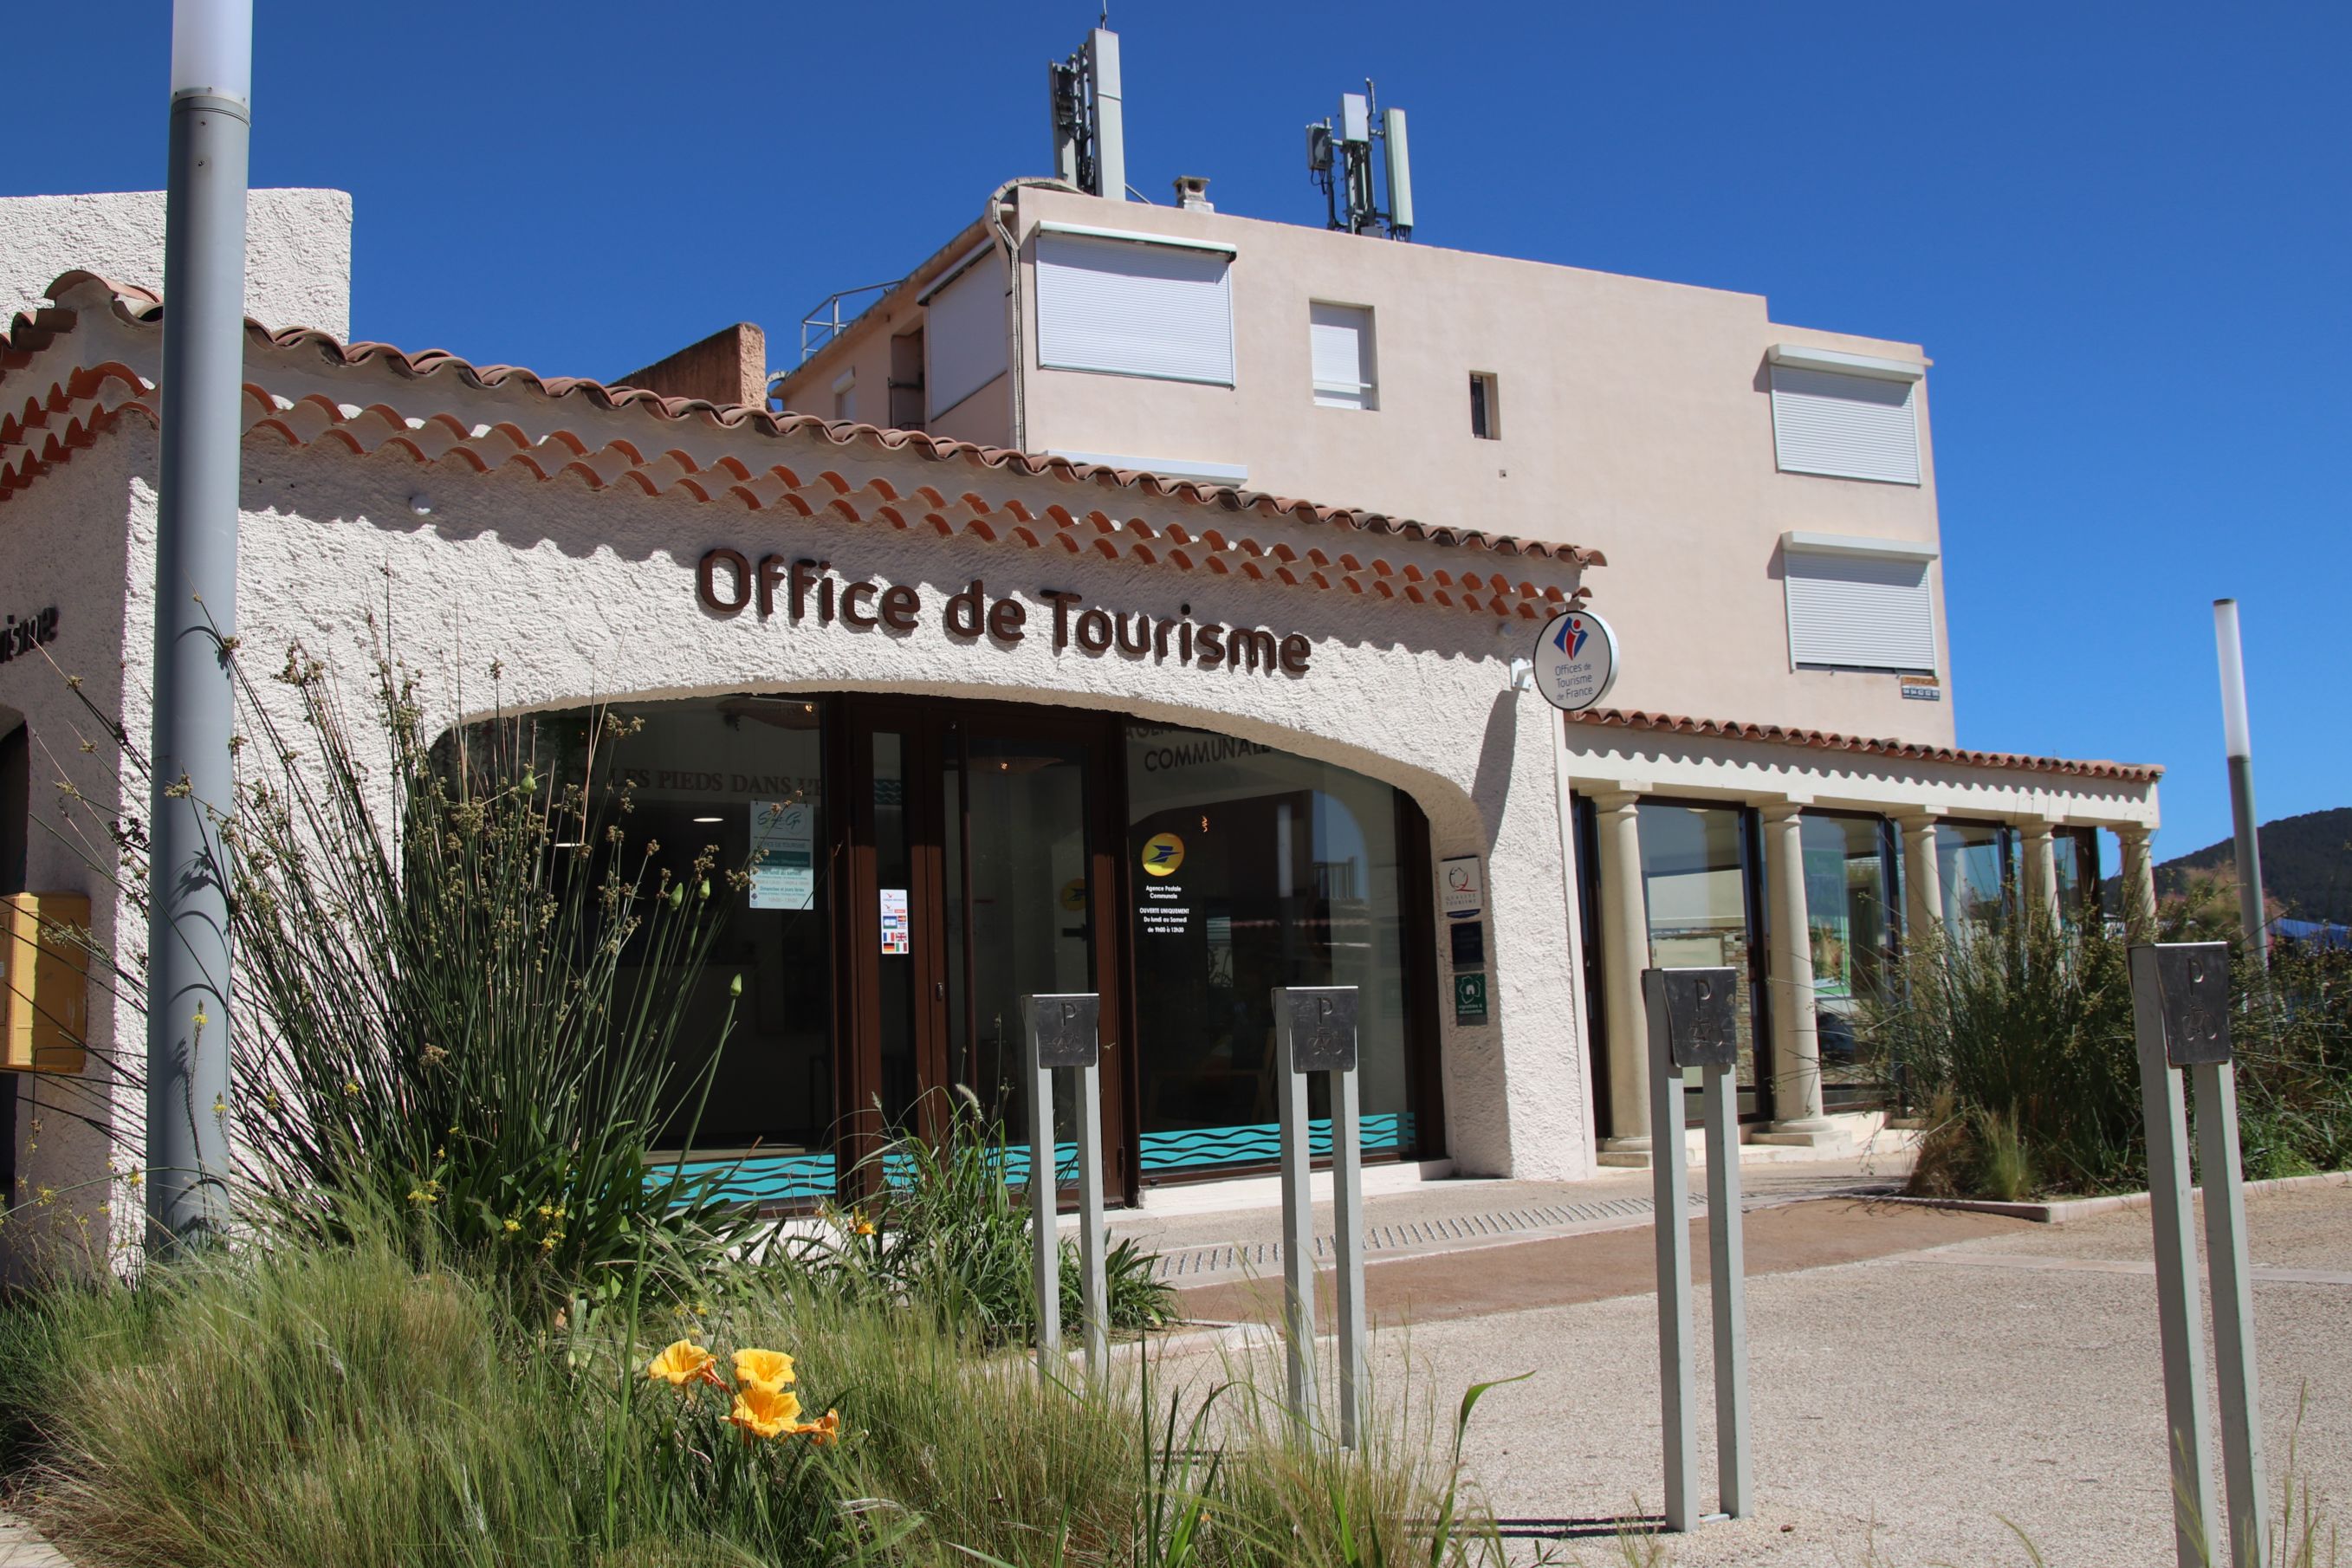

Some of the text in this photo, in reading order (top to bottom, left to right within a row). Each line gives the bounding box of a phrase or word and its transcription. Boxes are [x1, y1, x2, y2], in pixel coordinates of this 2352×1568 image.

[699, 548, 1312, 673] Office de Tourisme
[1554, 664, 1582, 676] Offices
[1556, 674, 1593, 689] Tourisme
[1565, 686, 1593, 698] France
[656, 769, 722, 792] PIEDS
[730, 774, 792, 795] DANS
[2187, 957, 2204, 996] P
[1694, 979, 1712, 1012] P
[1061, 1003, 1077, 1027] P
[1317, 997, 1333, 1024] P
